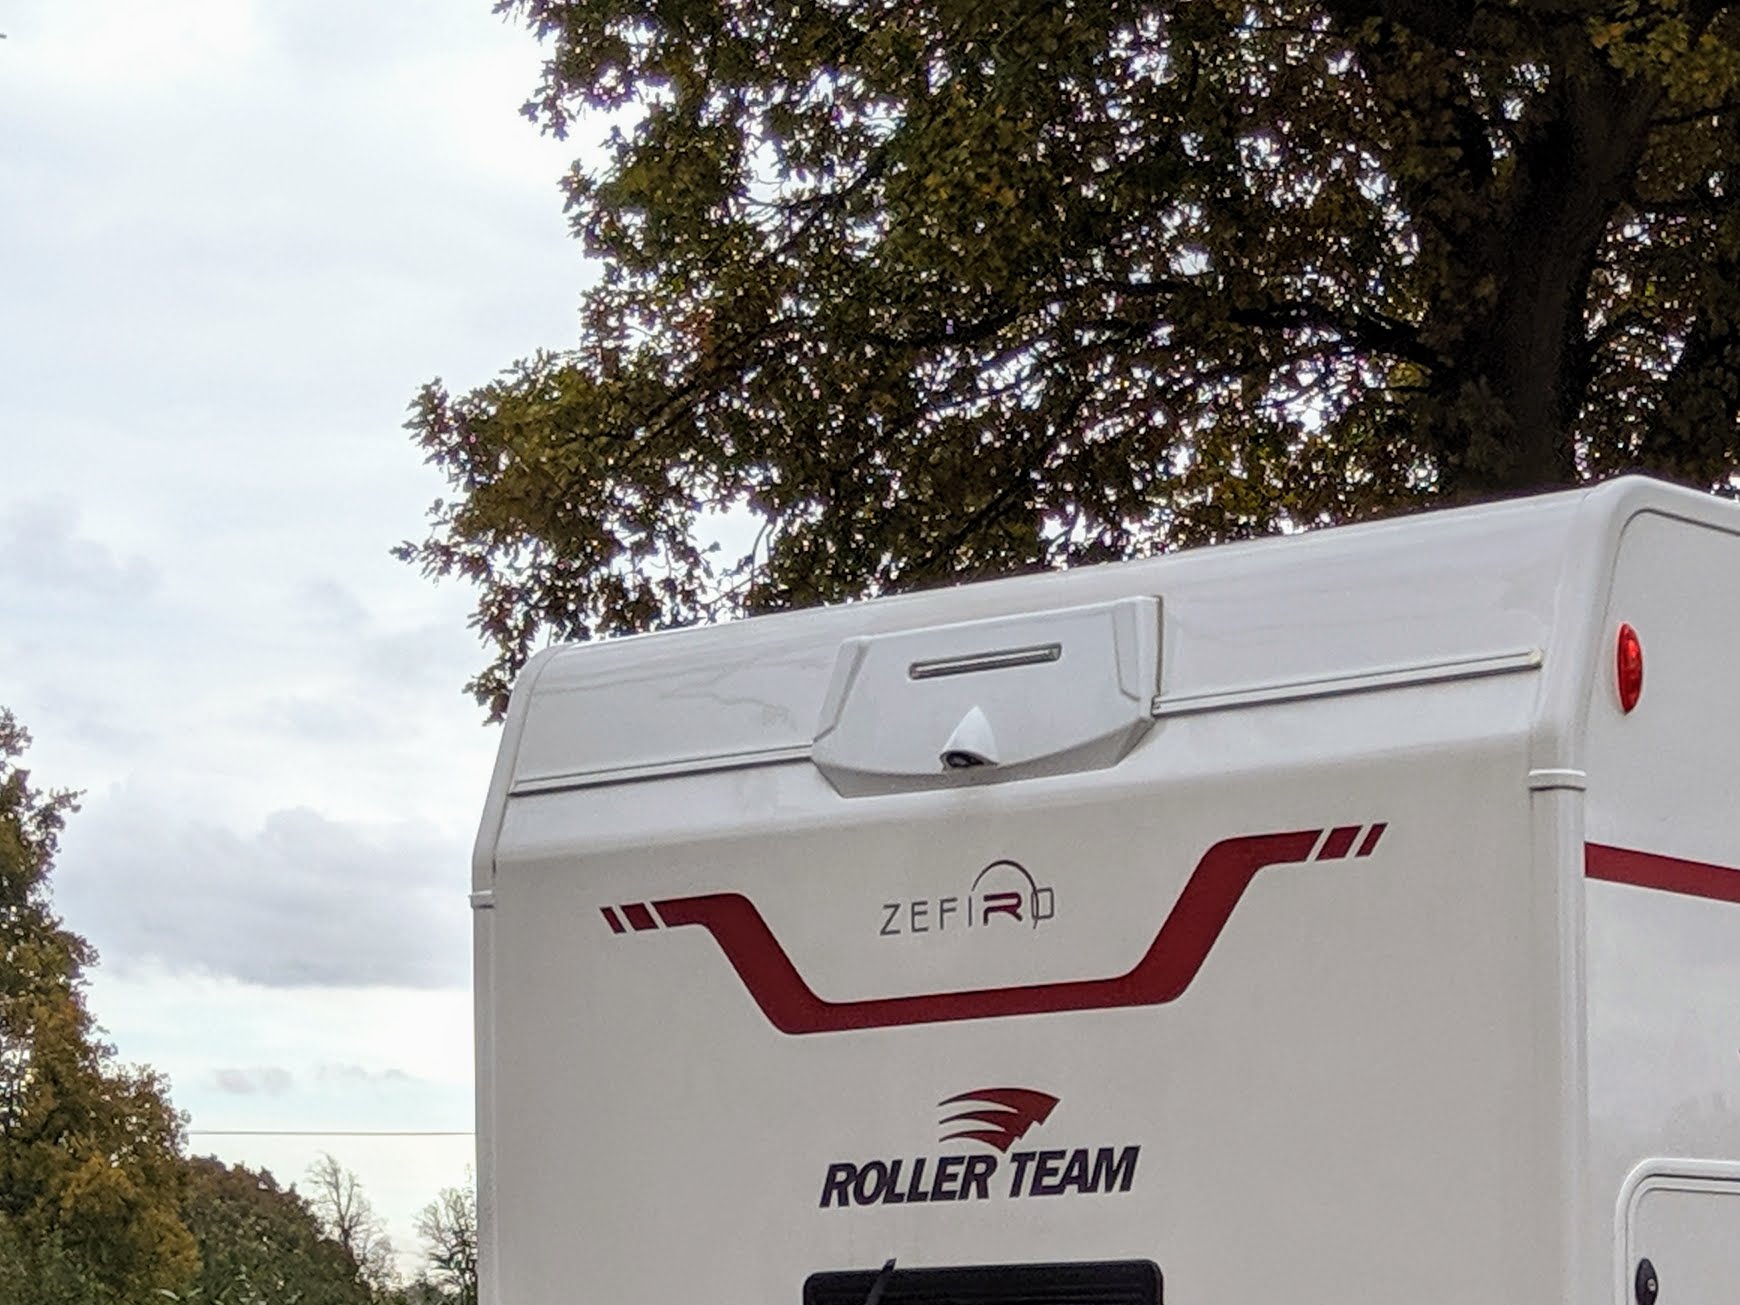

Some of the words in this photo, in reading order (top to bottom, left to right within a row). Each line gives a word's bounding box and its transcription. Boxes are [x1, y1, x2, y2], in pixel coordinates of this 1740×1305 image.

[879, 884, 1055, 936] ZEFIRO
[819, 1153, 998, 1208] ROLLER
[1008, 1145, 1142, 1198] TEAM
